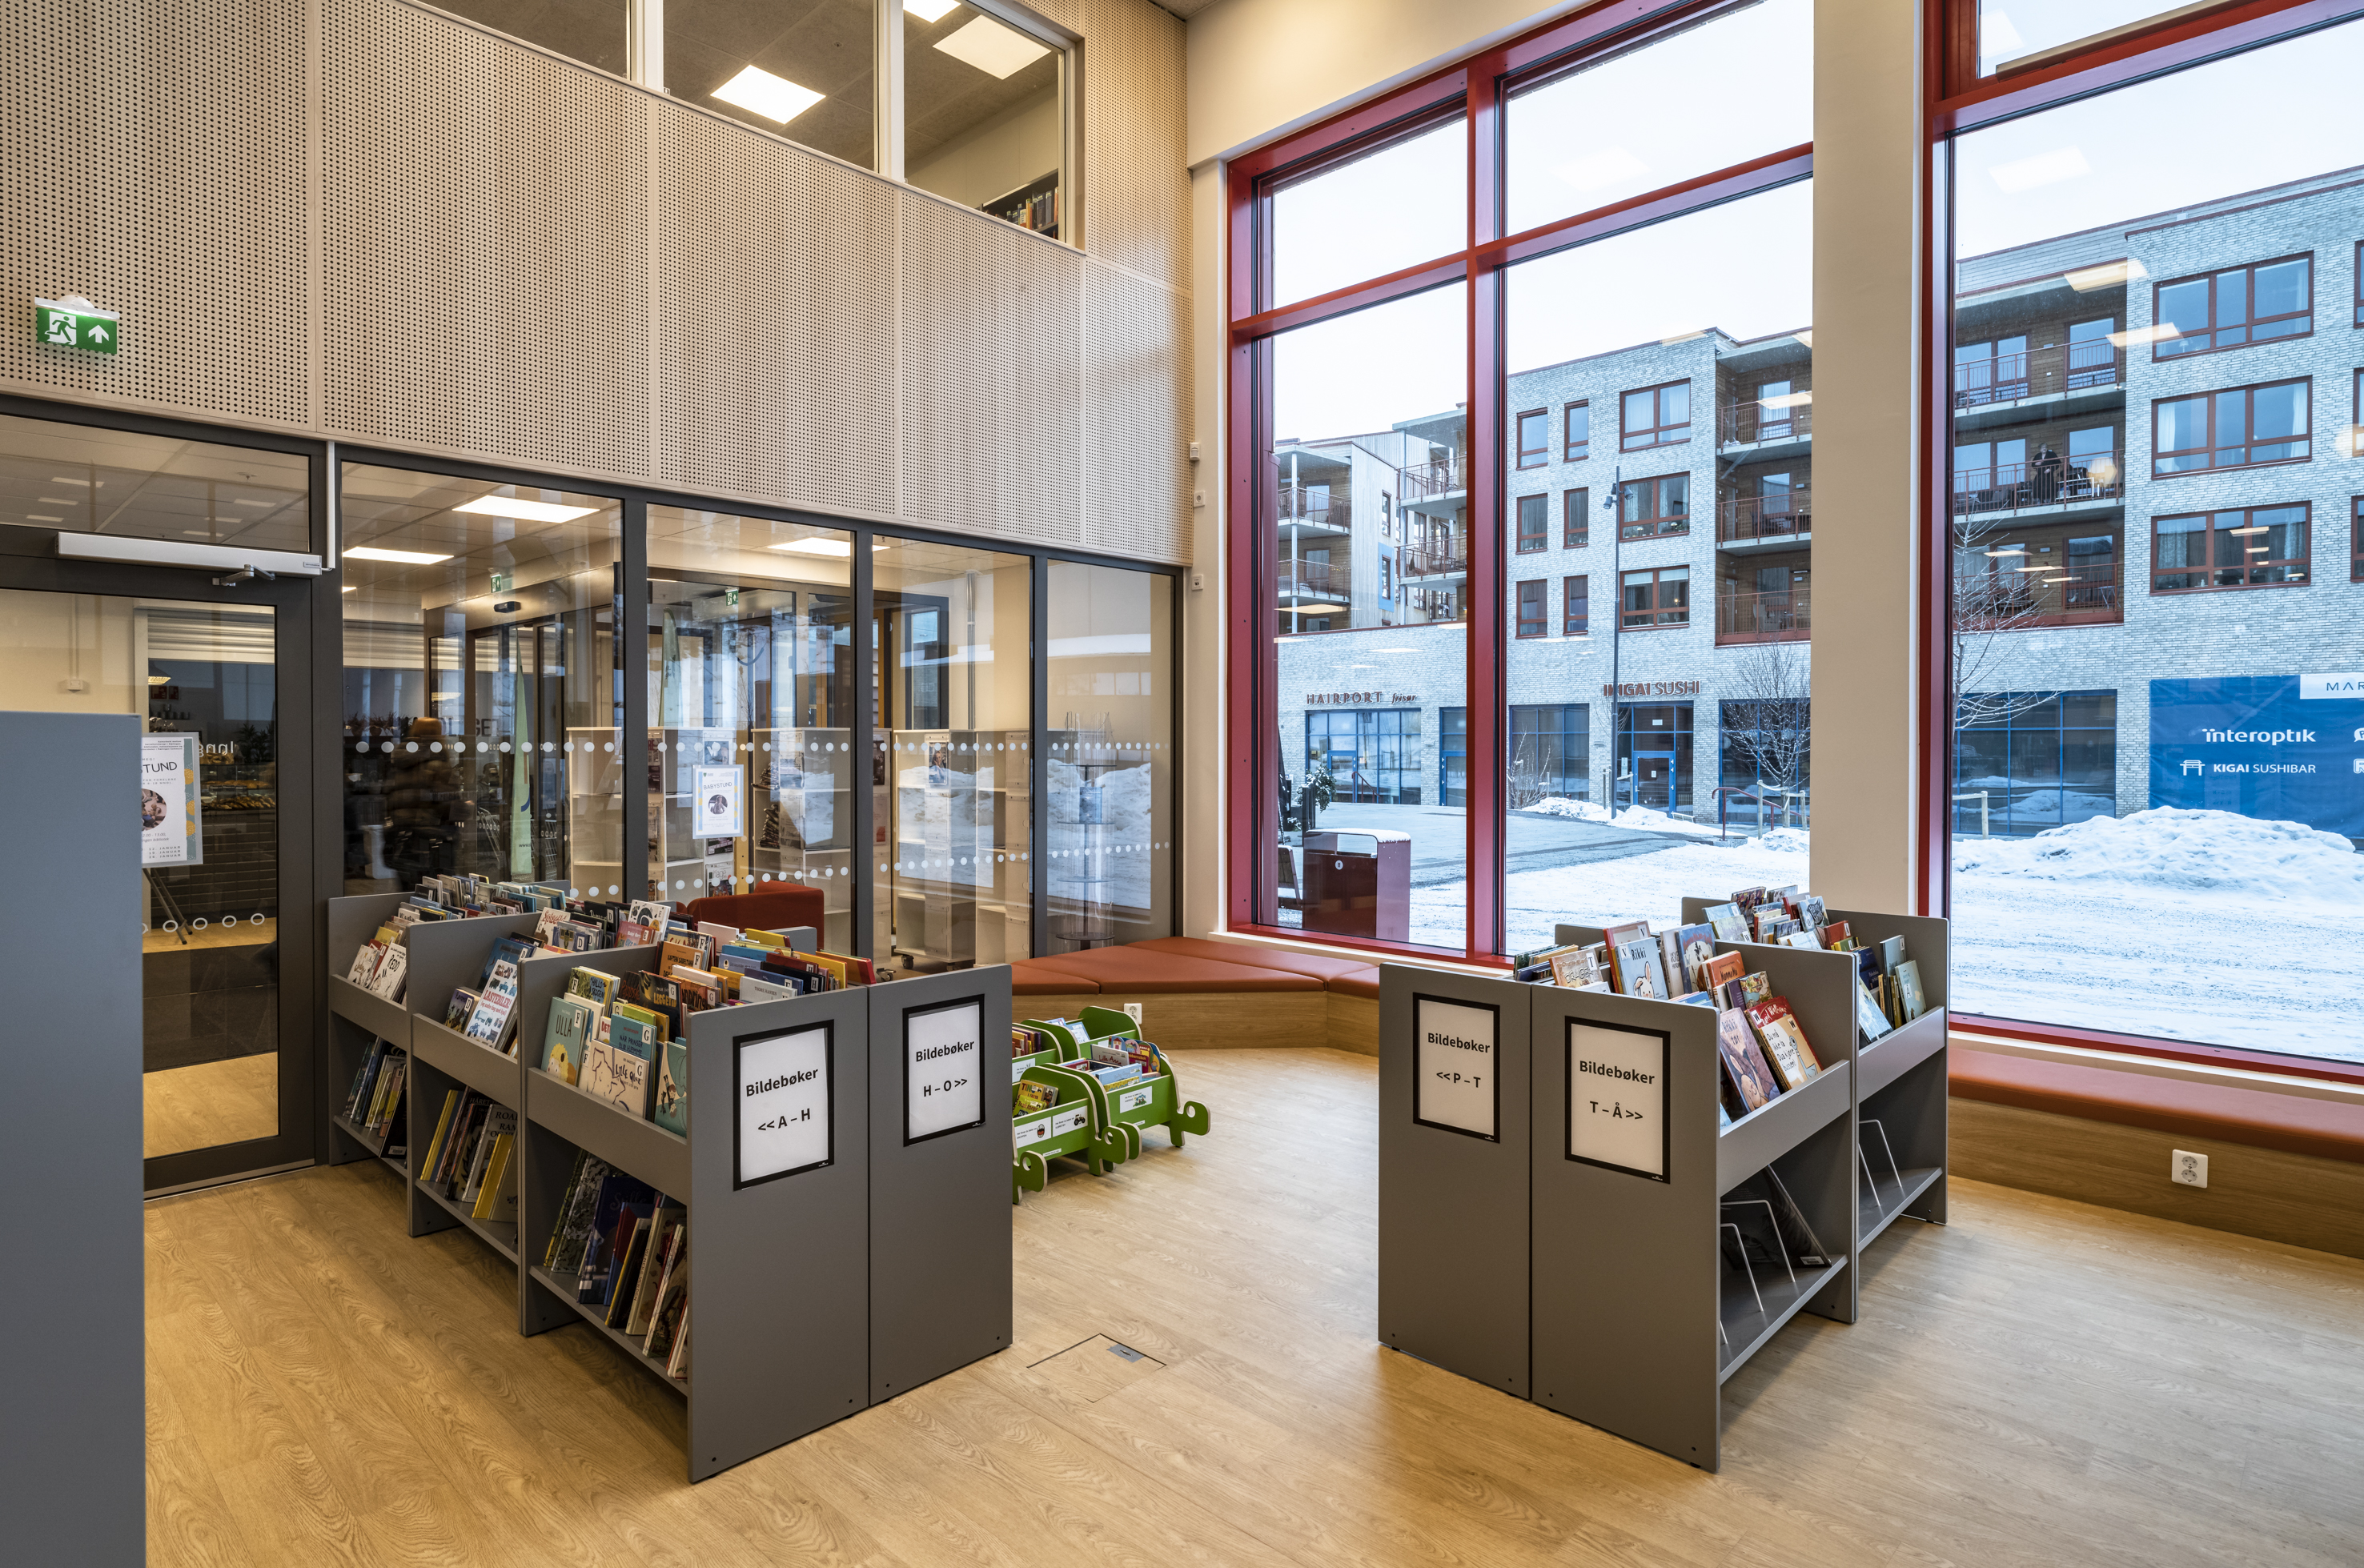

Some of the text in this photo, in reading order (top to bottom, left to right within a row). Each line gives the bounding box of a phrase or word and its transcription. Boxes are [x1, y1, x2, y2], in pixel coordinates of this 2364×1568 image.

[1655, 680, 1700, 695] SUSHI
[1306, 691, 1416, 704] HAIRPORT frisør
[142, 761, 178, 773] TUND
[2213, 764, 2316, 773] KIGAI SUSHIBAR
[703, 782, 732, 790] BABYSTUND
[694, 954, 700, 965] F
[1631, 947, 1647, 960] Rikki
[387, 954, 400, 972] REDD
[591, 976, 602, 987] HALLO
[483, 989, 512, 1009] LASTEBILER!
[556, 1014, 572, 1037] ULLA
[575, 1012, 580, 1024] F
[1789, 1020, 1796, 1029] W
[628, 1037, 643, 1048] PRINSER
[644, 1029, 650, 1041] G
[1428, 1032, 1490, 1053] Bildebøker
[916, 1041, 975, 1062] Bildebøker
[615, 1064, 628, 1079] LILLE
[637, 1065, 643, 1077] G
[1579, 1060, 1655, 1085] Bildebøker
[746, 1069, 819, 1097] Bildebøker
[1453, 1073, 1461, 1083] P
[1473, 1076, 1481, 1088] T
[923, 1085, 931, 1097] H
[943, 1080, 951, 1092] O
[1589, 1101, 1598, 1113] T
[1612, 1102, 1622, 1119] Å
[778, 1115, 788, 1129] A
[801, 1108, 811, 1121] H
